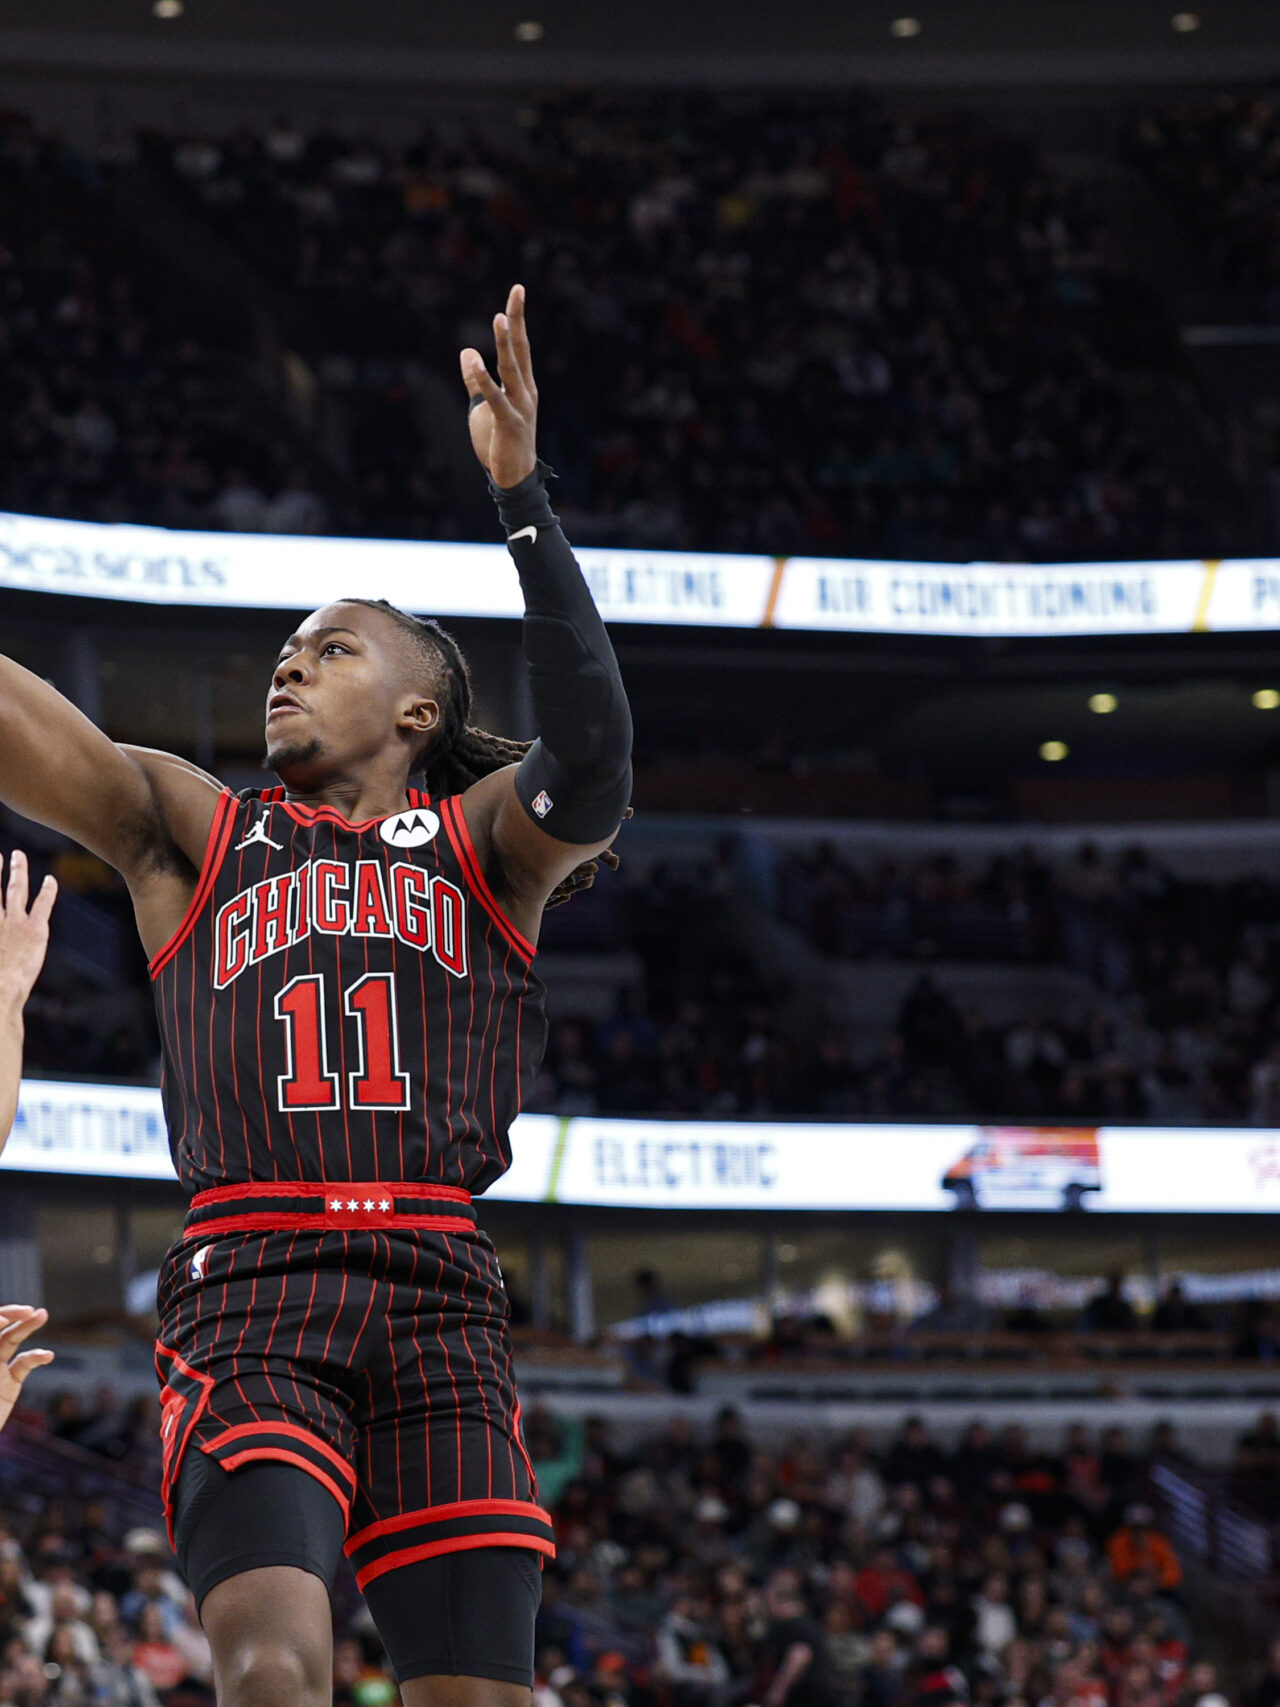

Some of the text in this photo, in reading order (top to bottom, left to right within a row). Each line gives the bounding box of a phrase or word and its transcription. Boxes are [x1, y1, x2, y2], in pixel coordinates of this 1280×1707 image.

[588, 565, 723, 608] EATING
[817, 574, 1157, 617] AIR CONDITIONING
[214, 858, 468, 990] CHICAGO
[274, 972, 411, 1112] 11
[594, 1137, 776, 1188] ELECTRIC
